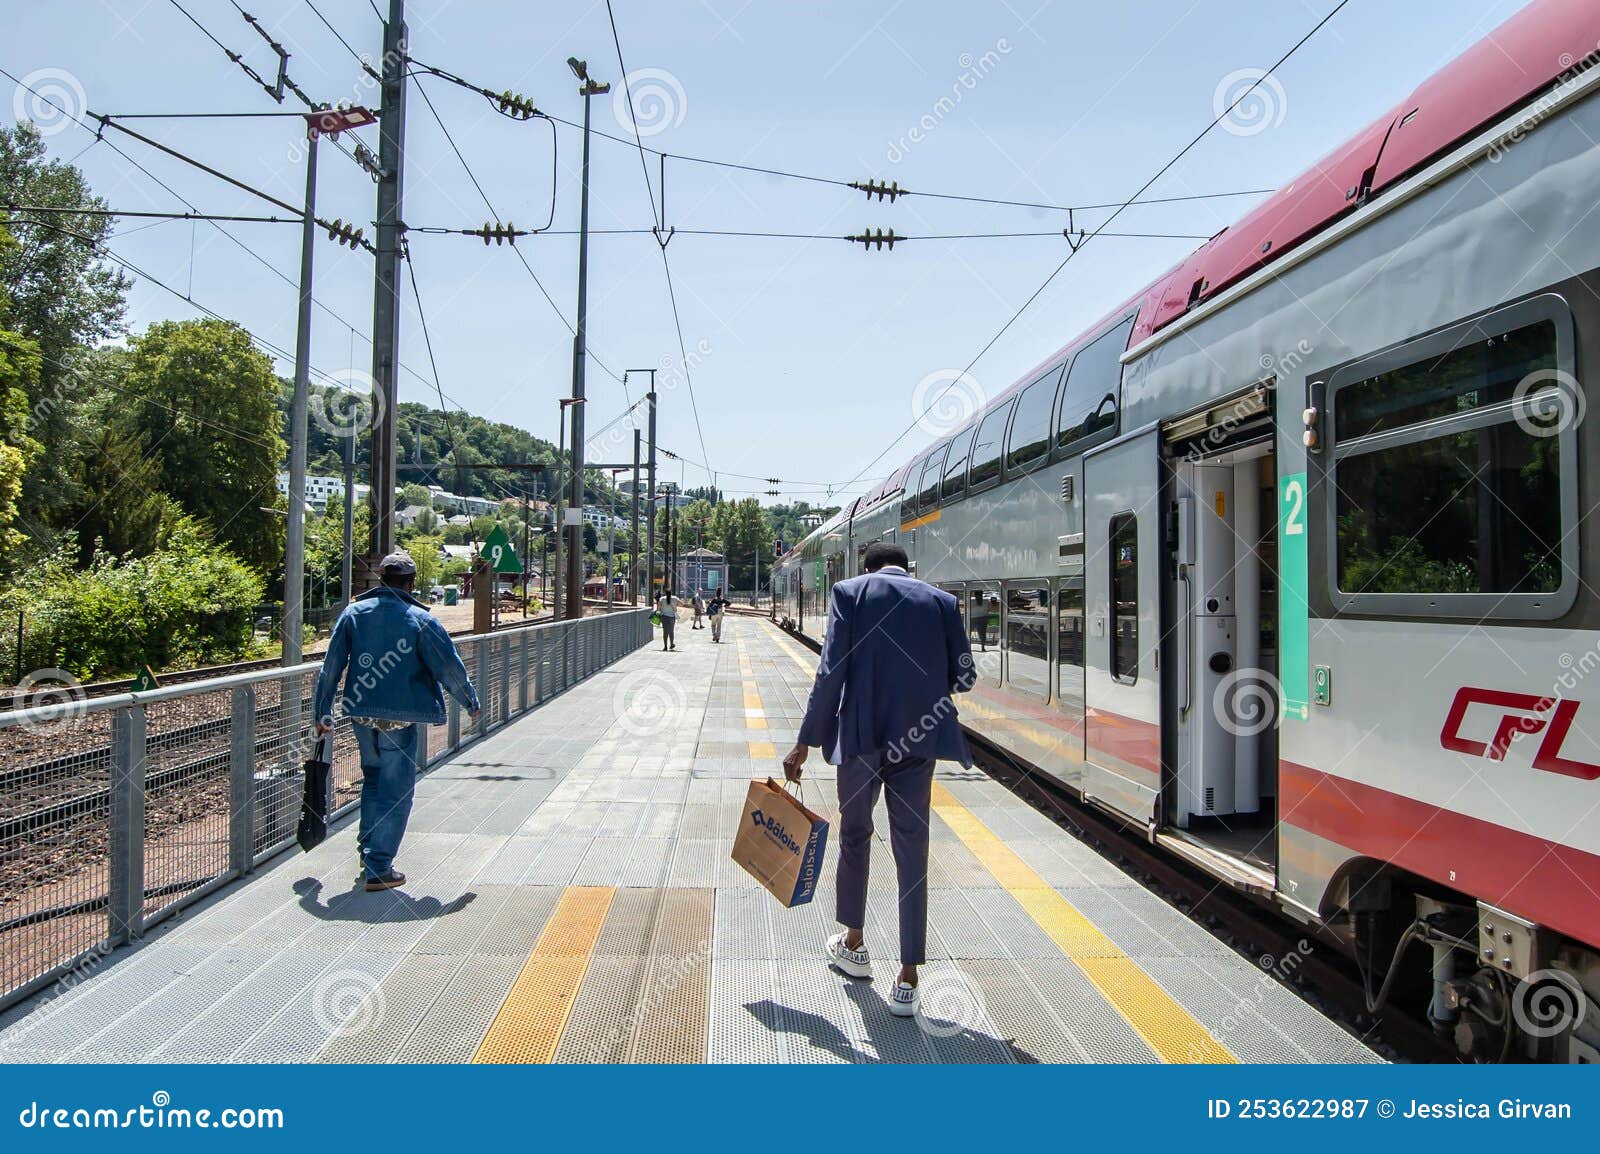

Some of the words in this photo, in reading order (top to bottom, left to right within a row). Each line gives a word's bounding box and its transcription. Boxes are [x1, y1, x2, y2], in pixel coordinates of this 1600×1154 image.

[1285, 480, 1304, 535] 2
[491, 544, 503, 568] 9
[142, 676, 149, 690] 9
[1440, 686, 1600, 780] CFL
